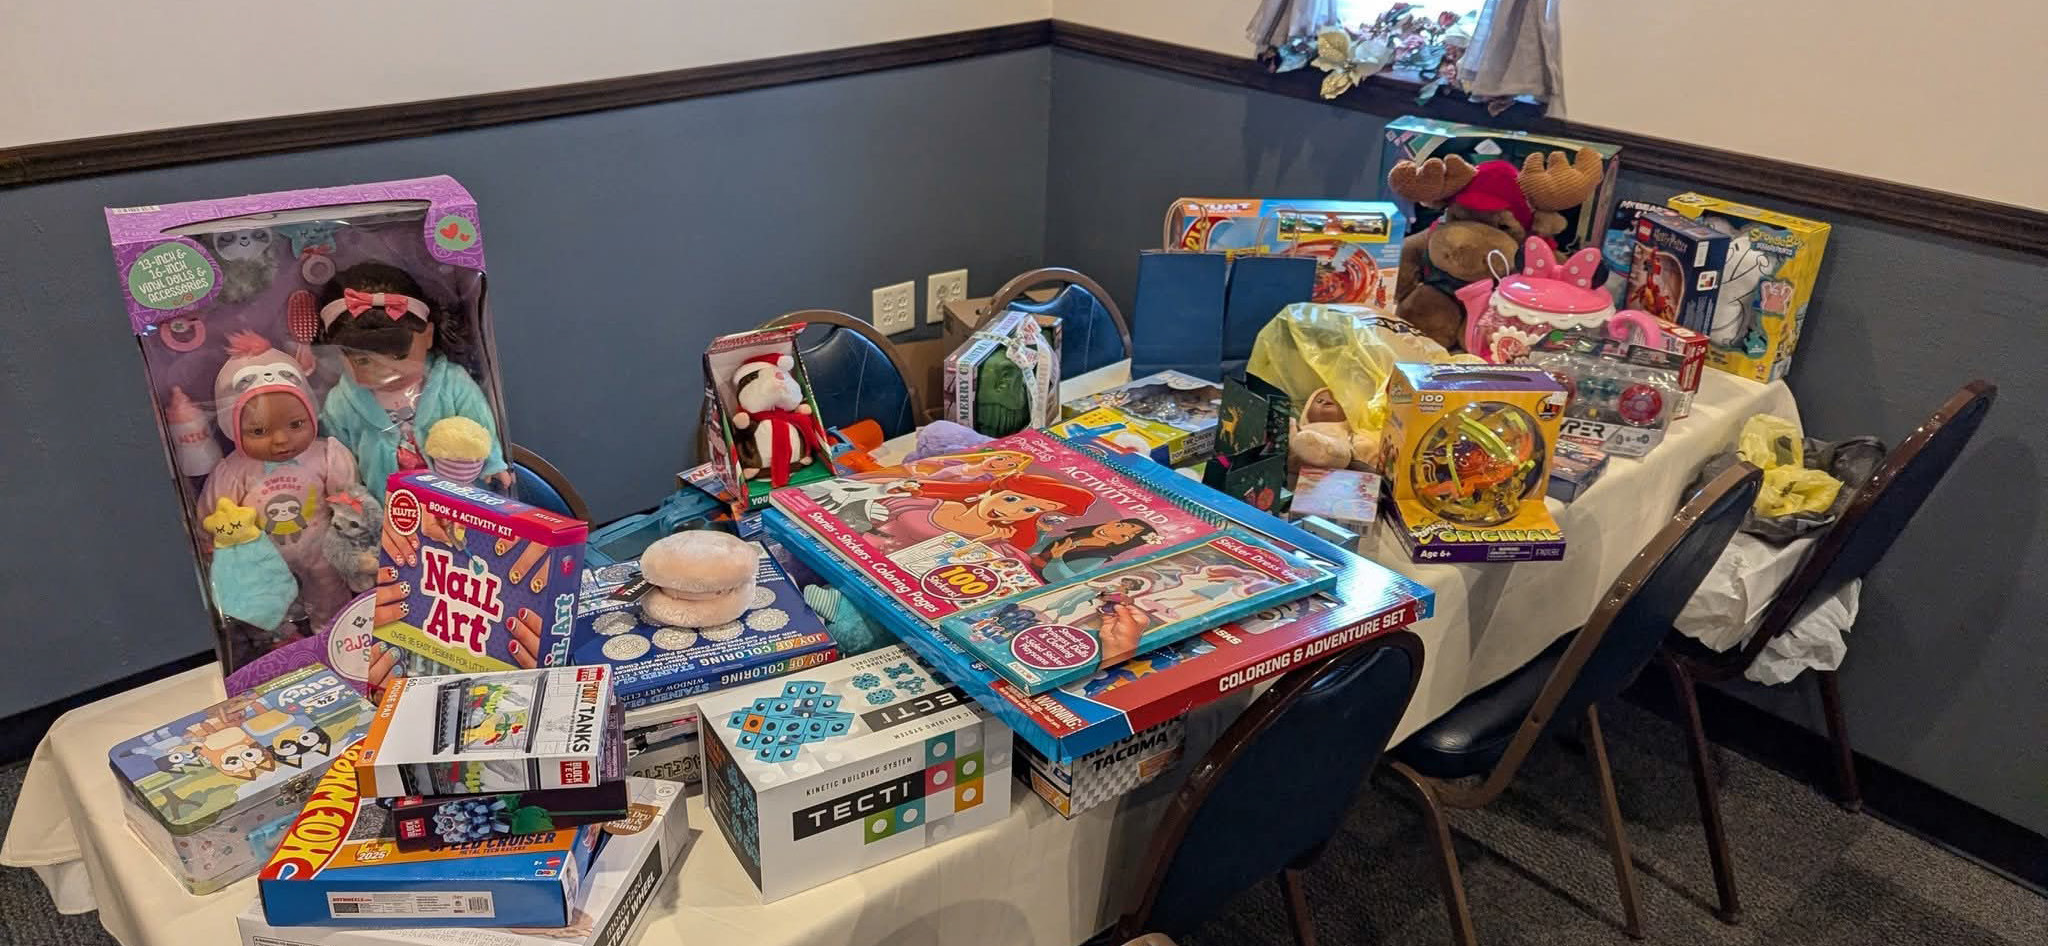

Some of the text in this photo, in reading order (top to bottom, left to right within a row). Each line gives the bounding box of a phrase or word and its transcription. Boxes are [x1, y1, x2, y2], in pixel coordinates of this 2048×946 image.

[176, 249, 186, 258] &
[197, 266, 206, 276] &
[1060, 466, 1168, 525] ACTIVITY PAD
[392, 506, 418, 518] KLUTZ
[429, 502, 512, 537] BOOK & ACTIVITY KIT
[1216, 539, 1252, 556] Sticker
[1420, 550, 1438, 558] Age
[808, 512, 940, 612] Stories Stickers Coloring Pages
[939, 566, 988, 594] 100
[972, 568, 994, 582] Over
[427, 600, 487, 652] Art
[776, 640, 796, 650] OF
[800, 633, 823, 645] JOY
[1219, 609, 1406, 692] COLORING & ADVENTURE SET
[700, 645, 772, 666] COLORING
[721, 651, 832, 685] JOY OF COLORING
[1034, 694, 1082, 730] WARNING:
[572, 706, 596, 752] TANKS
[894, 727, 923, 740] SYSTEM
[1093, 731, 1168, 772] TACOMA
[564, 762, 573, 784] TECH
[573, 762, 582, 783] BLOCK
[806, 756, 912, 796] KINETIC BUILDING SYSTEM
[808, 781, 909, 827] TECTI
[487, 832, 556, 848] CRUISER
[358, 852, 386, 860] 2025
[606, 872, 643, 939] motorized
[630, 874, 656, 914] WHEEL
